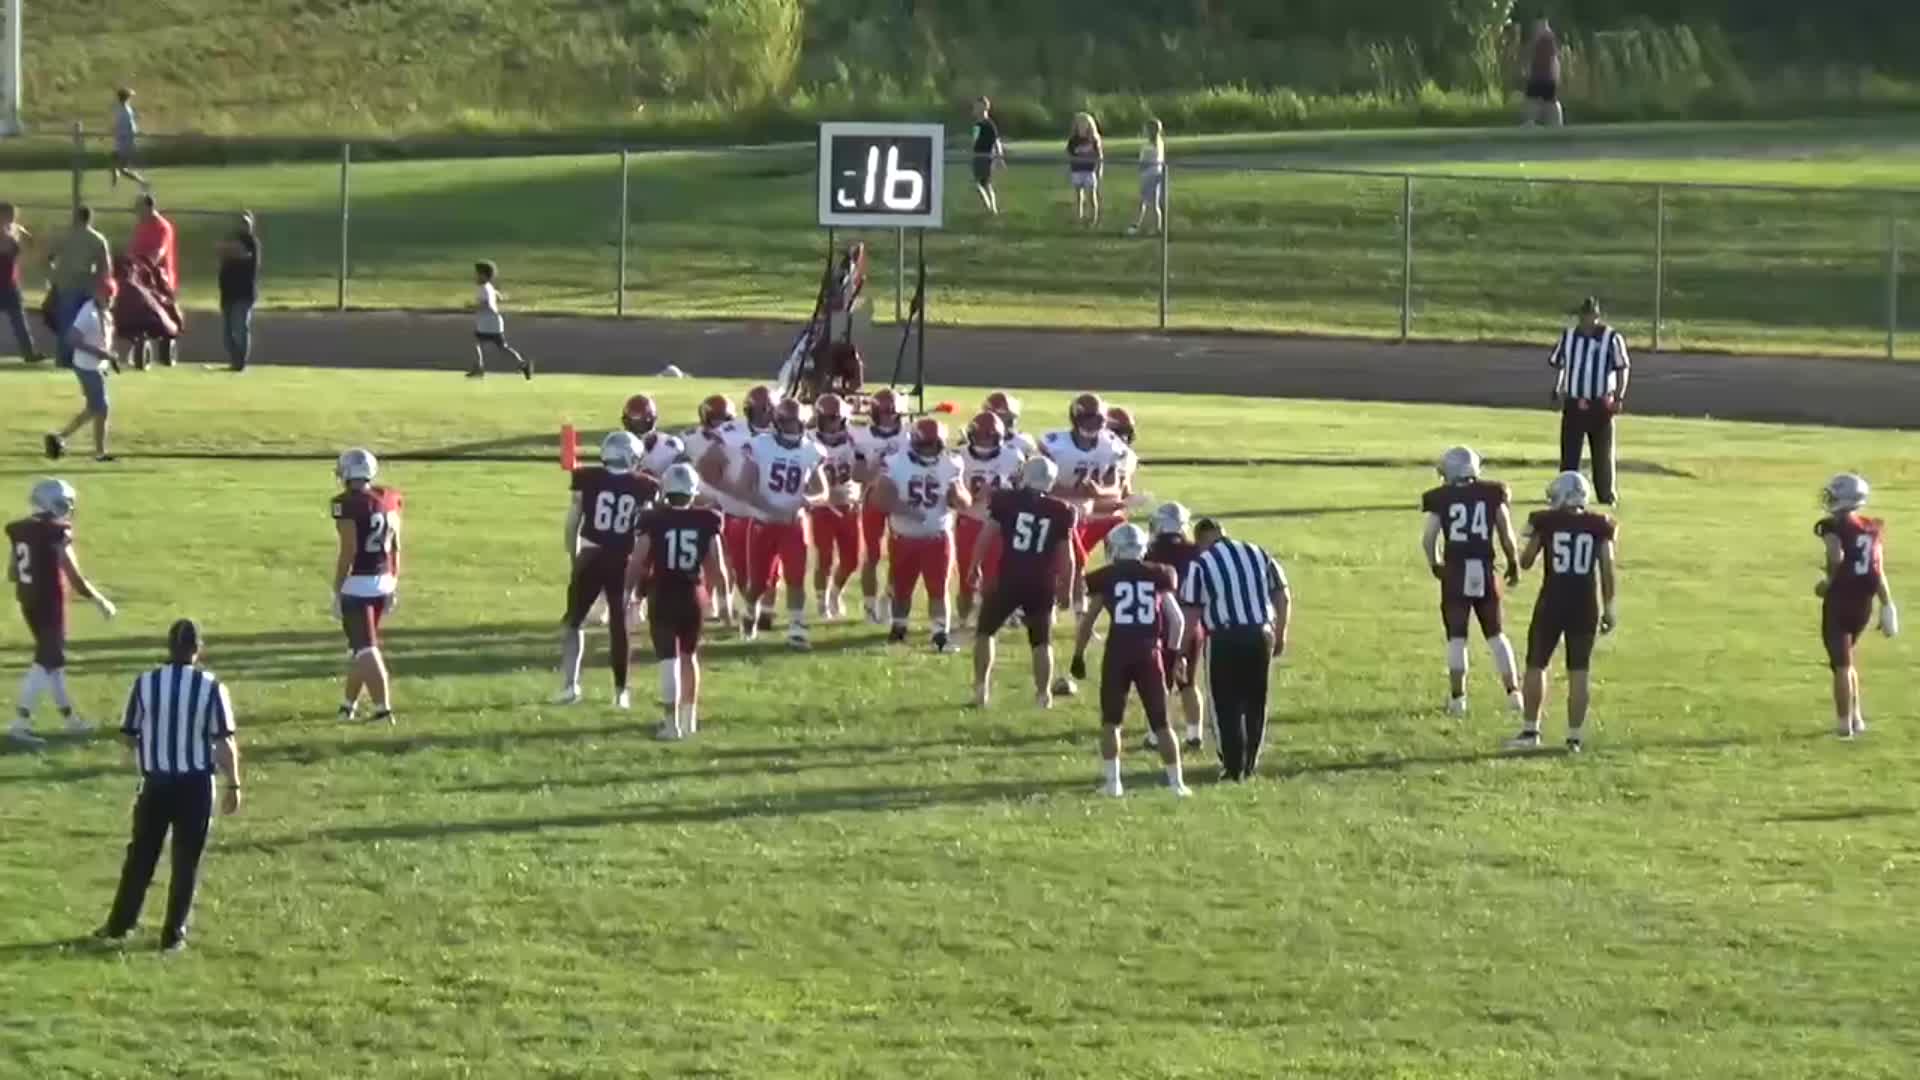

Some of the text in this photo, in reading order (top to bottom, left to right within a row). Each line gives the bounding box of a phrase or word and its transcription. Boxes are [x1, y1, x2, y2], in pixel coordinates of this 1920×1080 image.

[593, 491, 636, 534] 68
[908, 480, 939, 508] 55
[1012, 511, 1051, 553] 51
[1448, 500, 1489, 542] 24
[16, 541, 33, 584] 2
[664, 528, 698, 570] 15
[1552, 531, 1594, 575] 50
[1854, 533, 1873, 576] 3
[1114, 581, 1155, 625] 25
